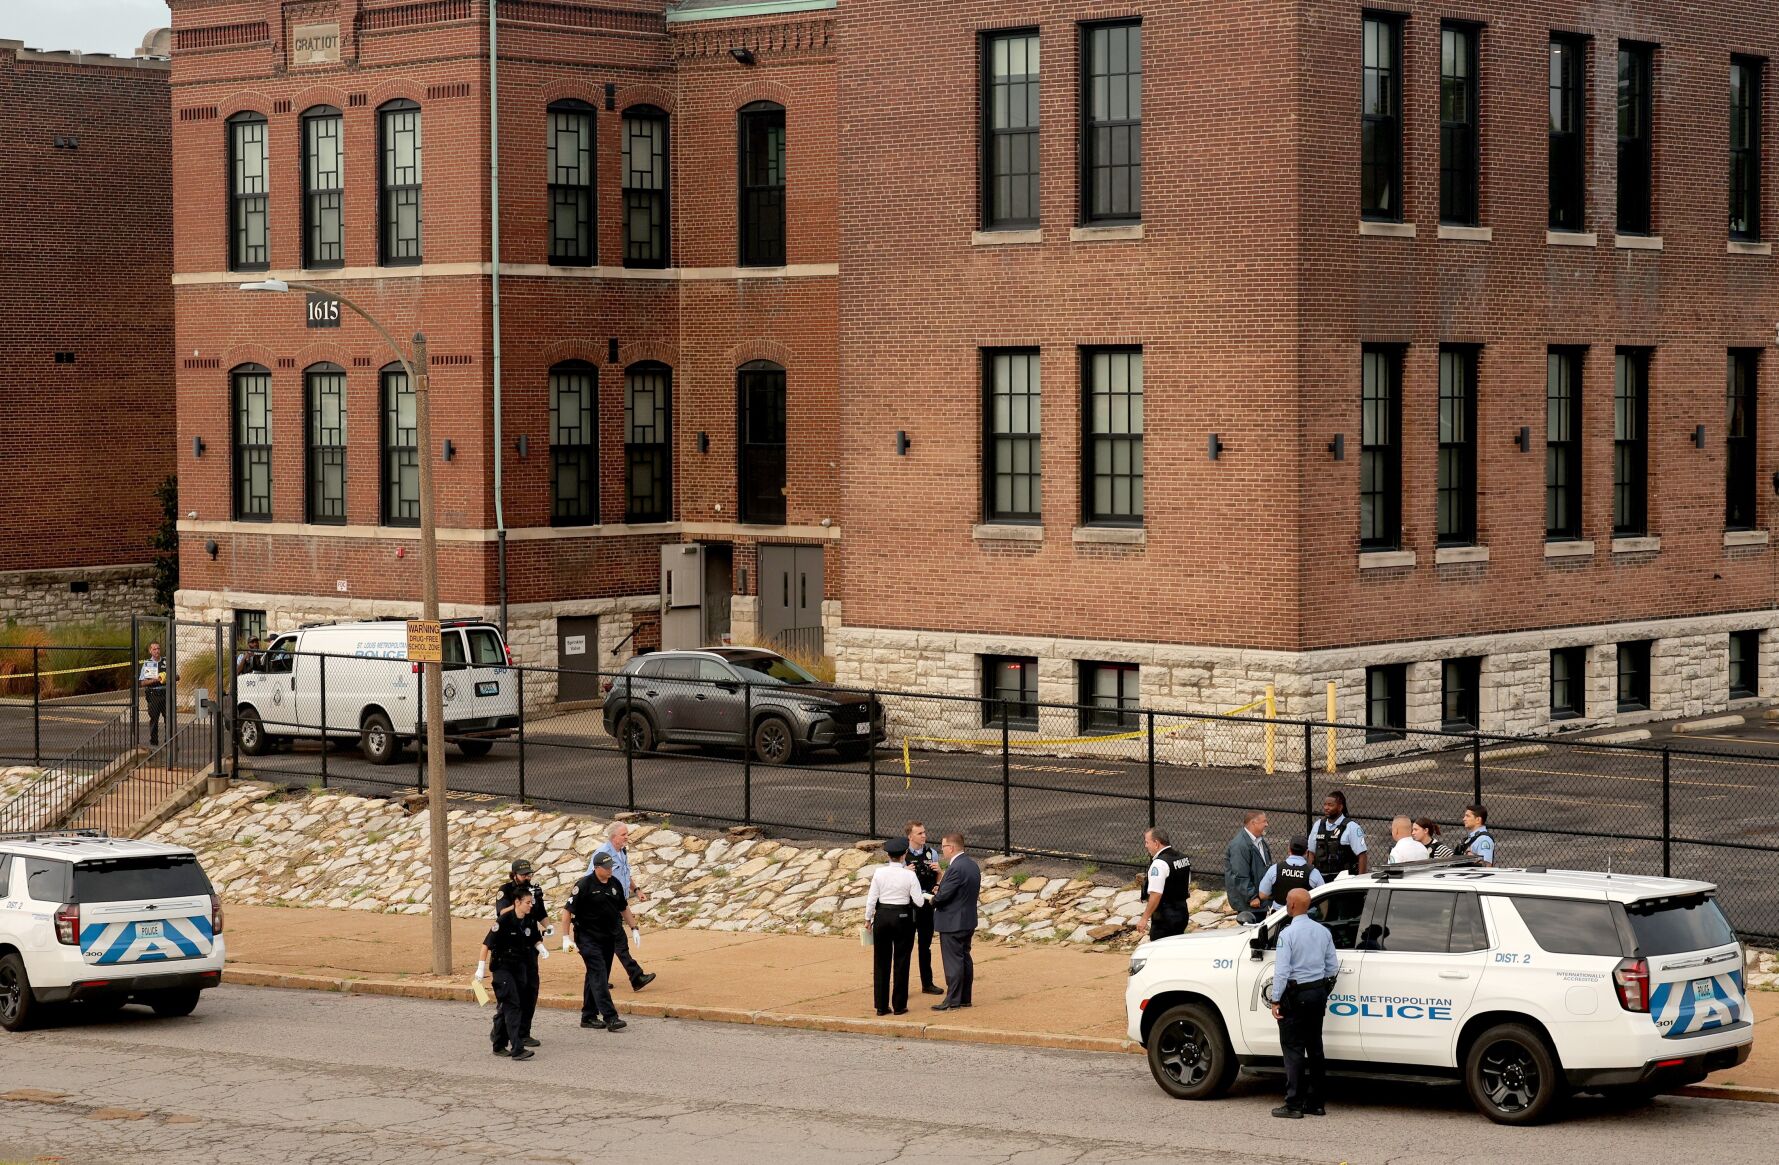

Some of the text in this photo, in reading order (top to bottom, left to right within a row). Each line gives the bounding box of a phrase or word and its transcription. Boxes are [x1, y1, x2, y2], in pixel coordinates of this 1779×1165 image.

[295, 36, 339, 51] GRATIOT
[308, 300, 339, 320] 1615
[408, 624, 440, 634] WARNING
[409, 635, 439, 643] DRUG-FREE
[408, 643, 427, 651] SCHOOL
[1173, 857, 1191, 870] POLICE
[1281, 868, 1305, 879] POLICE
[141, 926, 158, 936] POLICE
[1212, 958, 1233, 969] 301
[1495, 953, 1531, 964] DIST. 2
[1556, 971, 1606, 979] INTERNATIONALLY
[1360, 995, 1452, 1006] METROPOLITAN
[1656, 1020, 1674, 1028] 301
